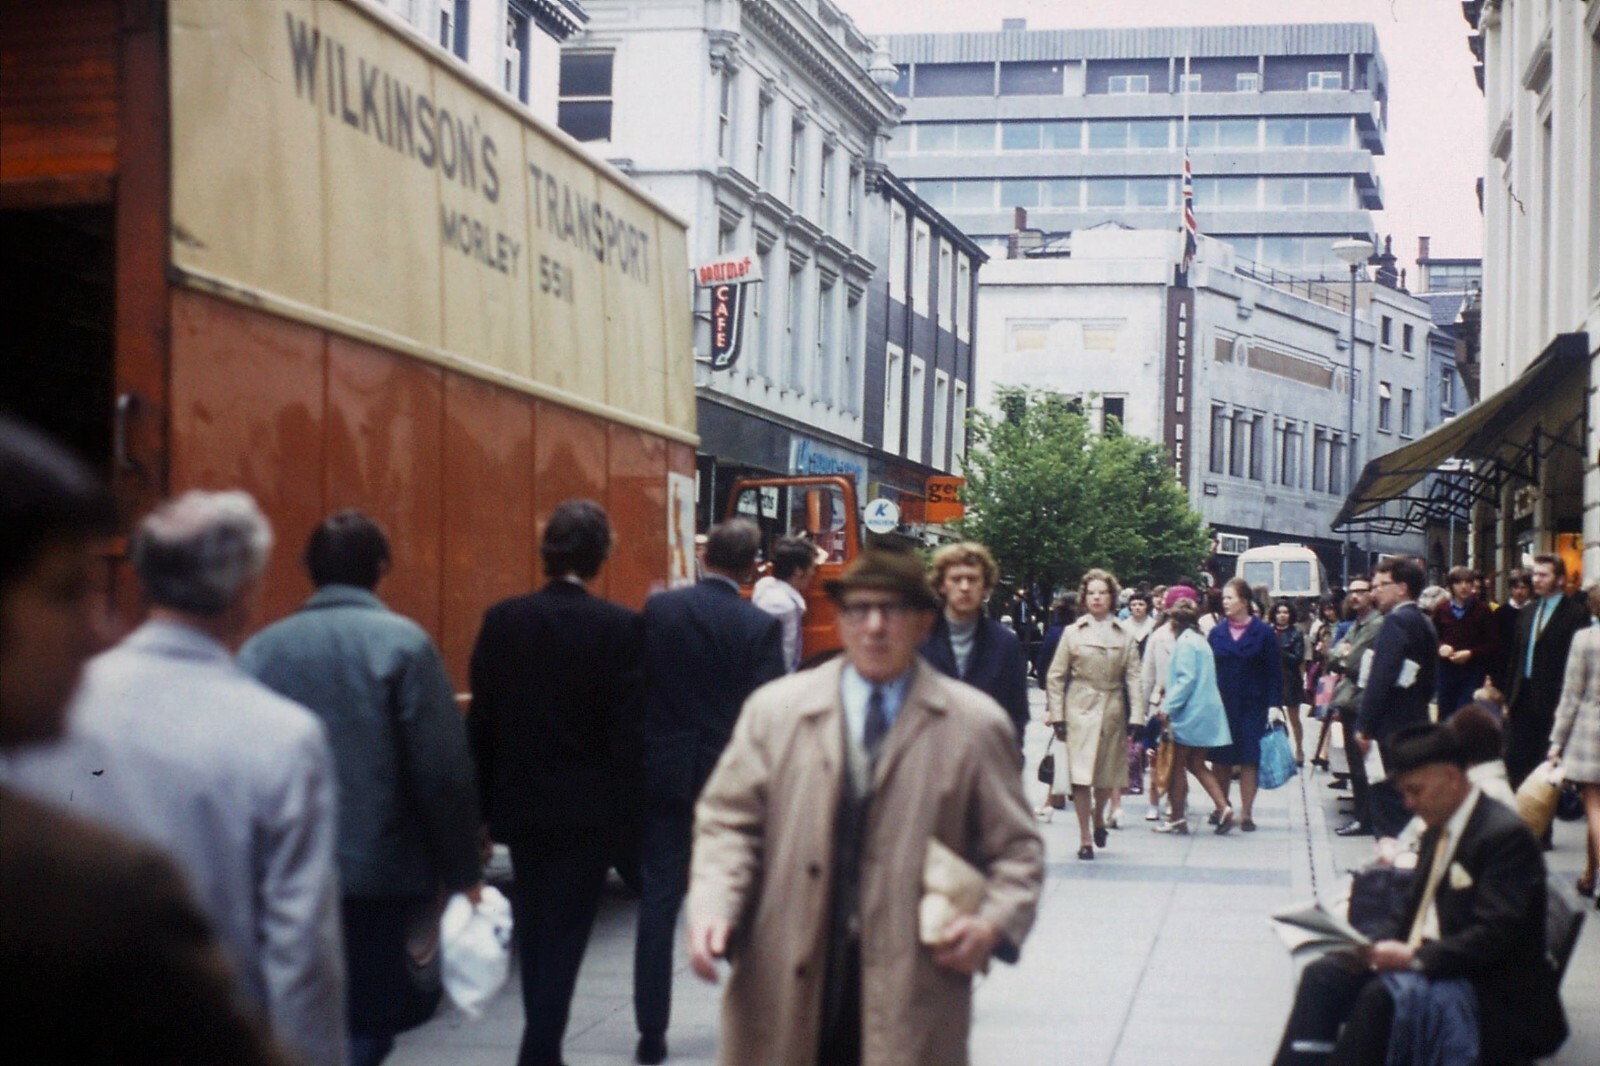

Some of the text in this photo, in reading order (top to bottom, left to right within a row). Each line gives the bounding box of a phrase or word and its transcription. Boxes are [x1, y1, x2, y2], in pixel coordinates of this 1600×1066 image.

[286, 11, 650, 286] WILKINSON'S TRANSPORT
[440, 204, 521, 278] MORLEY
[715, 285, 729, 347] CAFE
[1175, 302, 1187, 413] AUSTIN
[874, 503, 889, 517] K
